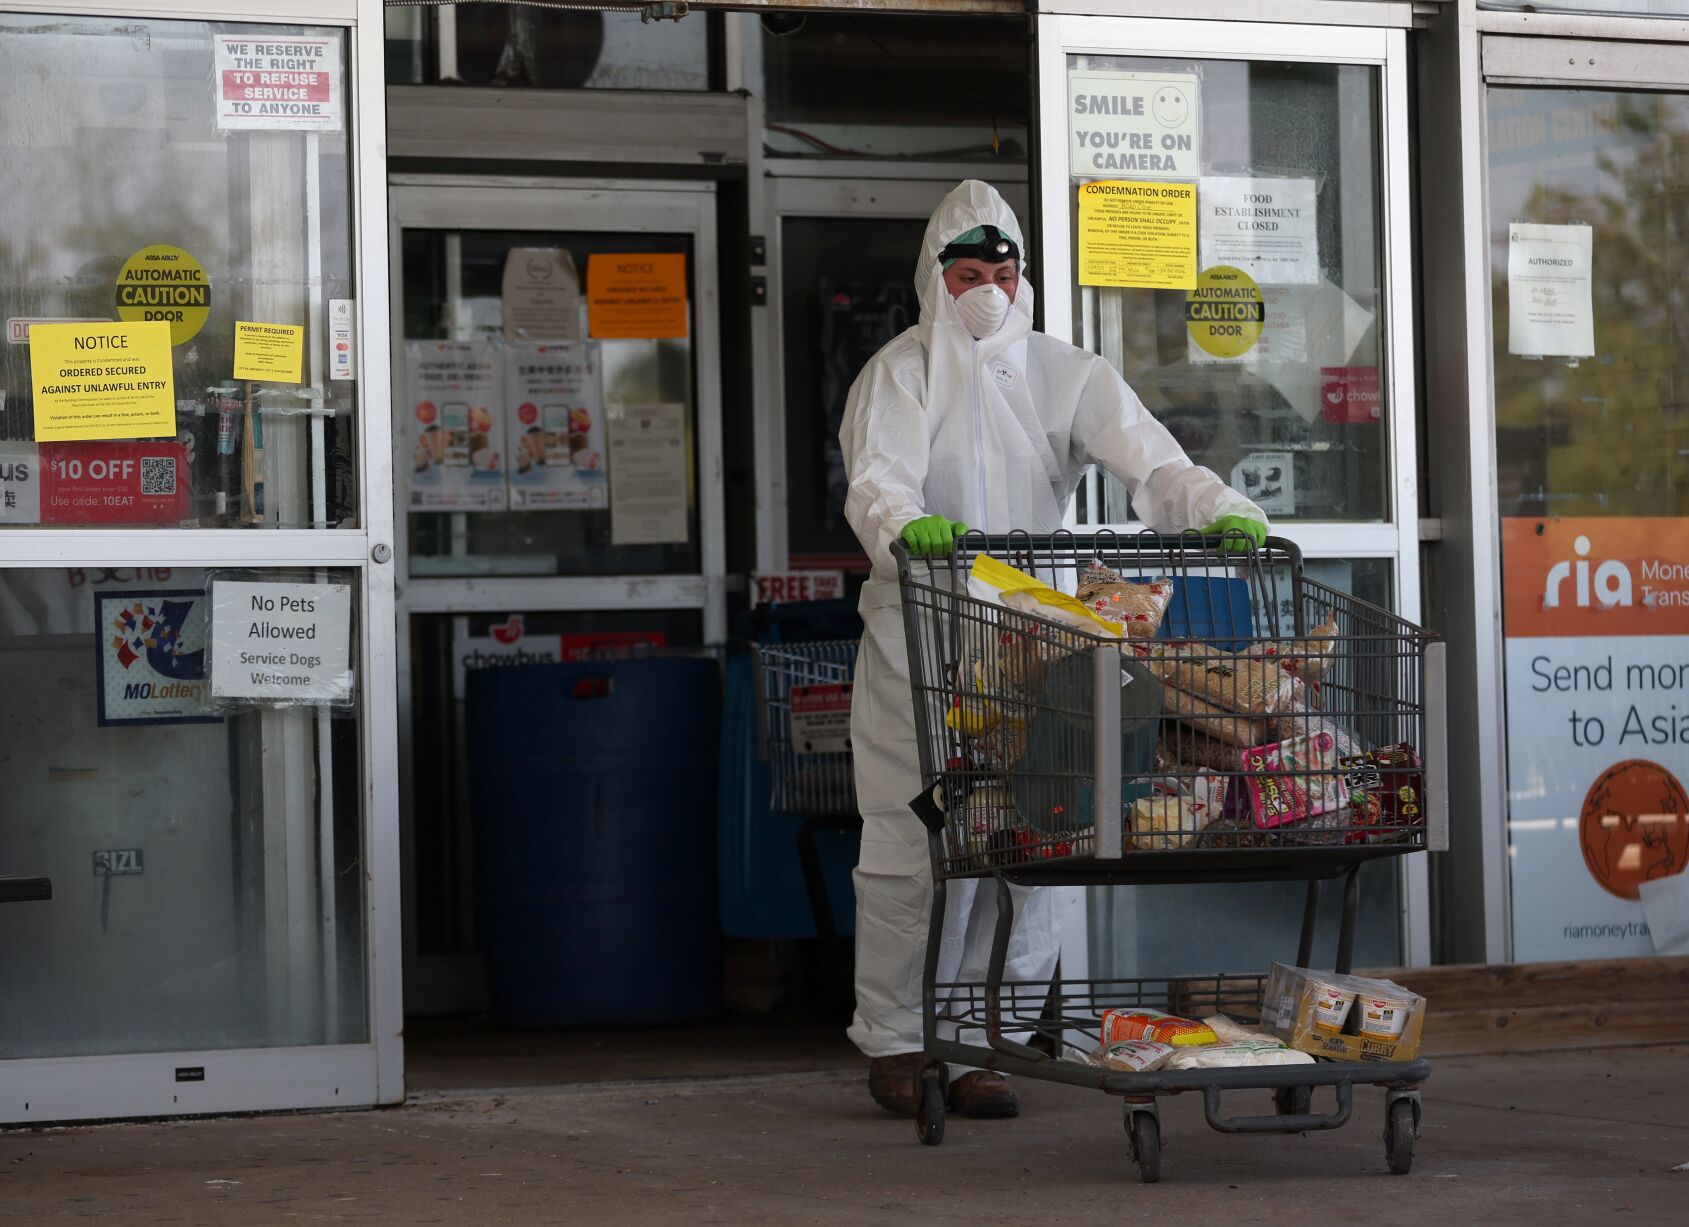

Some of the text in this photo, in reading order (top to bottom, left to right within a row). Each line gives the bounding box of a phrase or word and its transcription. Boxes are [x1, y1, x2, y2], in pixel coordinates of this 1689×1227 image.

[226, 44, 323, 57] WE RESERVE
[234, 58, 317, 70] THE RIGHT
[233, 73, 318, 86] TO REFUSE
[244, 87, 308, 100] SERVICE
[232, 102, 321, 116] TO ANYONE
[1074, 94, 1145, 116] SMILE
[1075, 131, 1192, 152] YOU'RE ON
[1092, 153, 1177, 172] CAMERA
[1086, 186, 1191, 199] CONDEMNATION ORDER
[1244, 194, 1272, 204] FOOD
[1214, 206, 1301, 218] ESTABLISHMENT
[1237, 221, 1279, 231] CLOSED
[1528, 258, 1574, 267] AUTHORIZED
[125, 268, 202, 282] AUTOMATIC
[121, 286, 206, 306] CAUTION
[1193, 287, 1257, 299] AUTOMATIC
[144, 310, 184, 322] DOOR
[1190, 303, 1260, 320] CAUTION
[264, 327, 294, 336] REQUIRED
[1209, 325, 1242, 336] DOOR
[74, 335, 129, 351] NOTICE
[60, 366, 146, 378] ORDERED SECURED
[41, 381, 166, 394] AGAINST UNLAWFUL ENTRY
[51, 460, 135, 480] $10 OFF
[51, 496, 71, 506] Use
[104, 496, 135, 506] 10EAT
[1546, 535, 1633, 608] ria
[758, 576, 809, 601] FREE
[251, 596, 315, 613] No Pets
[248, 622, 316, 640] Allowed
[240, 652, 321, 668] Service Dogs
[250, 672, 311, 686] Welcome
[1531, 654, 1612, 692] Send
[1568, 710, 1604, 747] to
[1360, 1038, 1396, 1057] CURRY
